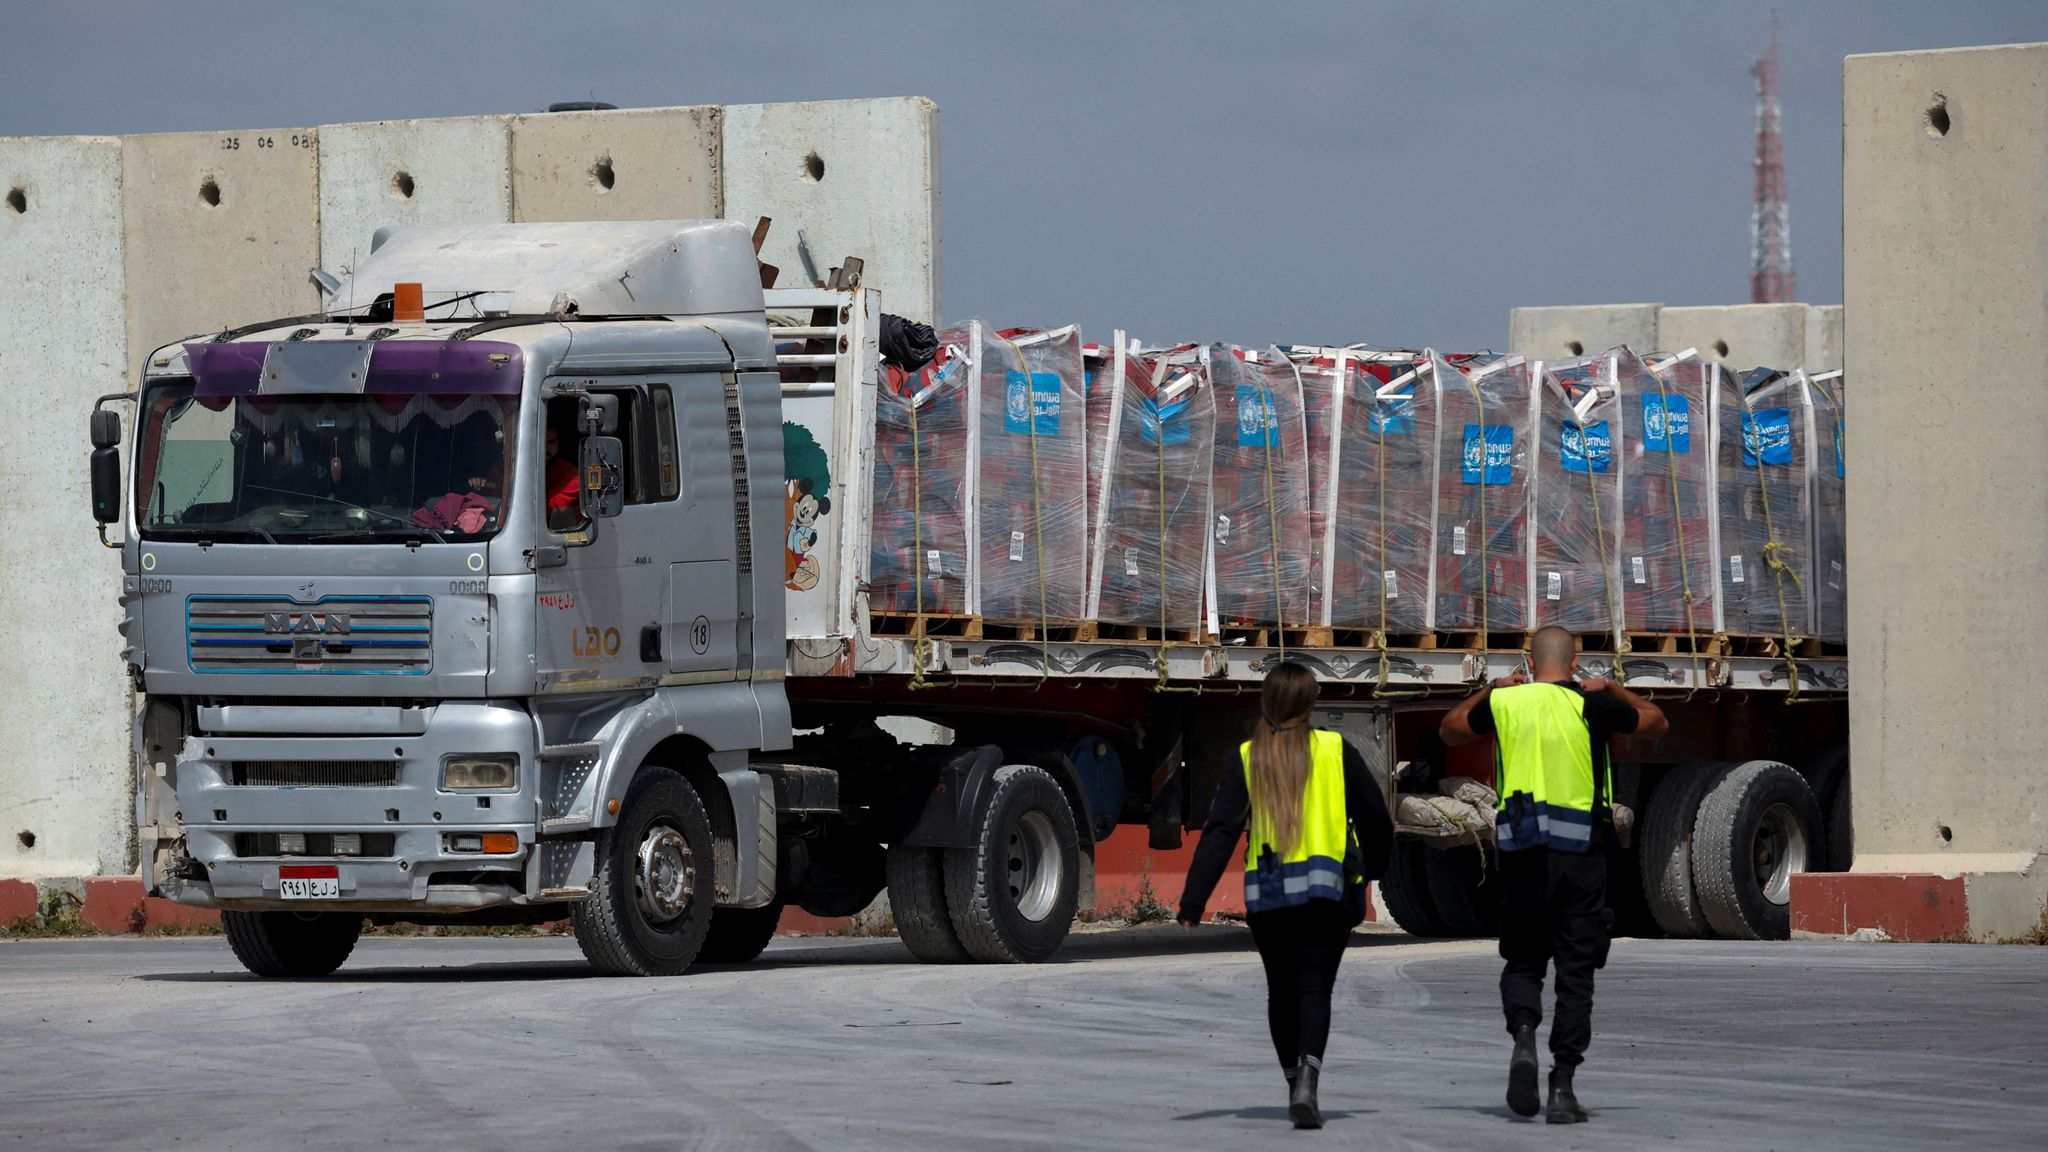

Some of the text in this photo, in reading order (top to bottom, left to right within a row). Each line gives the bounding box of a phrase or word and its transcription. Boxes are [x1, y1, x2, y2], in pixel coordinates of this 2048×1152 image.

[257, 136, 274, 149] 06
[1032, 391, 1060, 403] unrwa
[264, 612, 351, 634] MAN
[693, 625, 707, 645] 18
